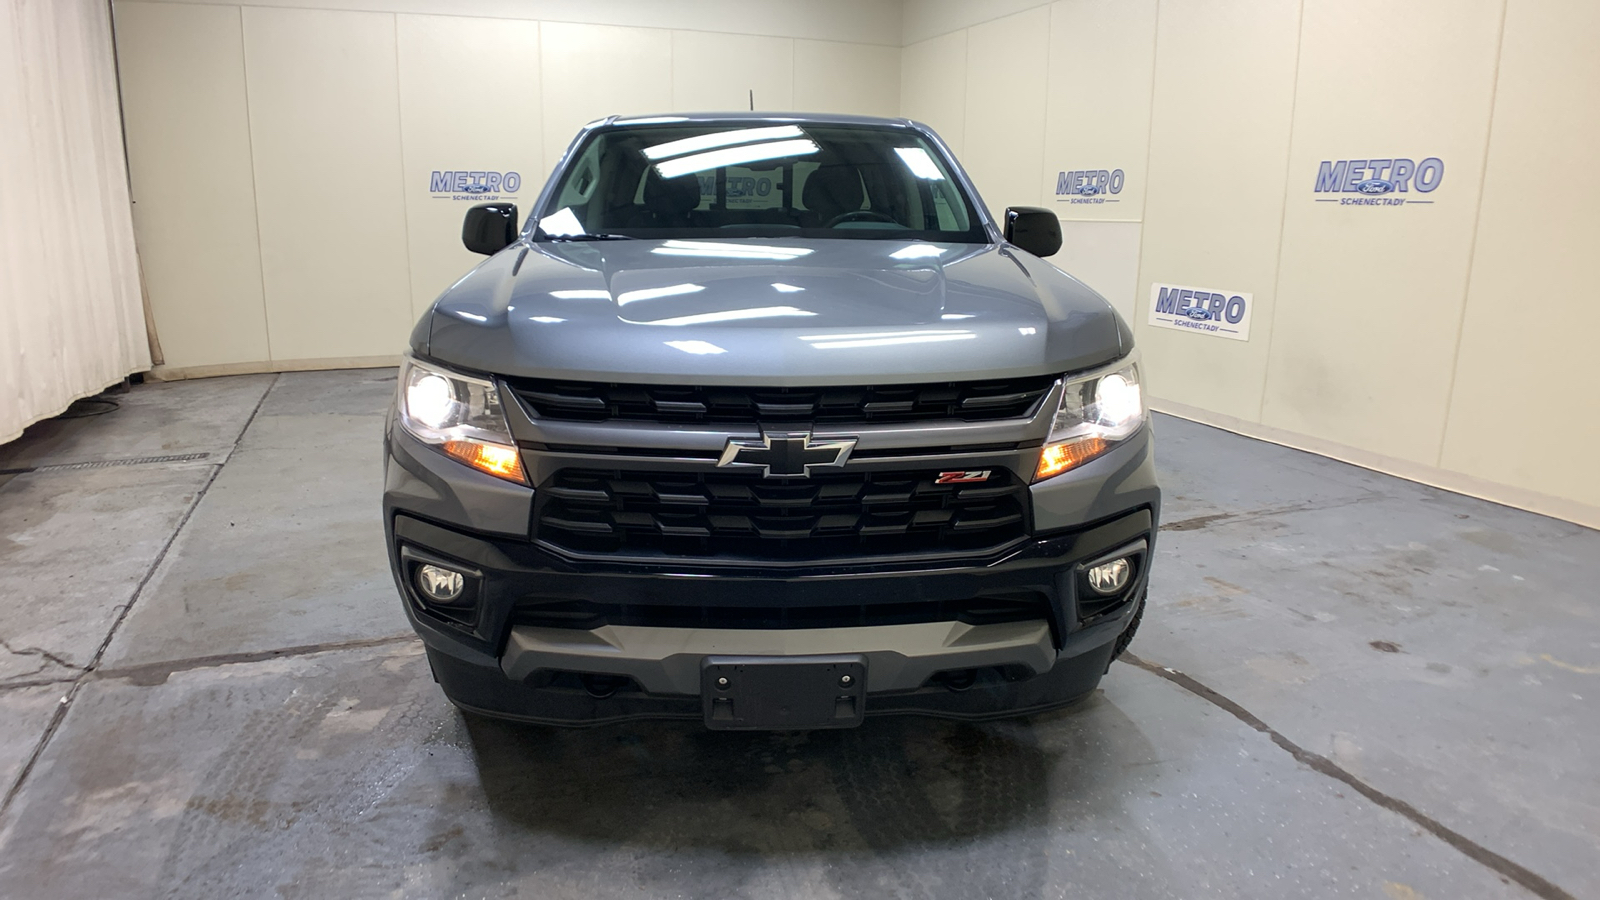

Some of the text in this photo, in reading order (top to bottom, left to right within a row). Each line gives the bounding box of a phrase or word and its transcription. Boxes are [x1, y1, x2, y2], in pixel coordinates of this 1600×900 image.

[430, 171, 521, 193] METRO
[1056, 169, 1124, 195] METRO
[1314, 157, 1444, 193] METRO
[698, 176, 771, 196] MTRO
[1362, 183, 1386, 193] Ford
[1340, 198, 1406, 206] SCHENECTADY
[1155, 287, 1246, 324] METRO
[1173, 319, 1219, 332] SCHENECTADY
